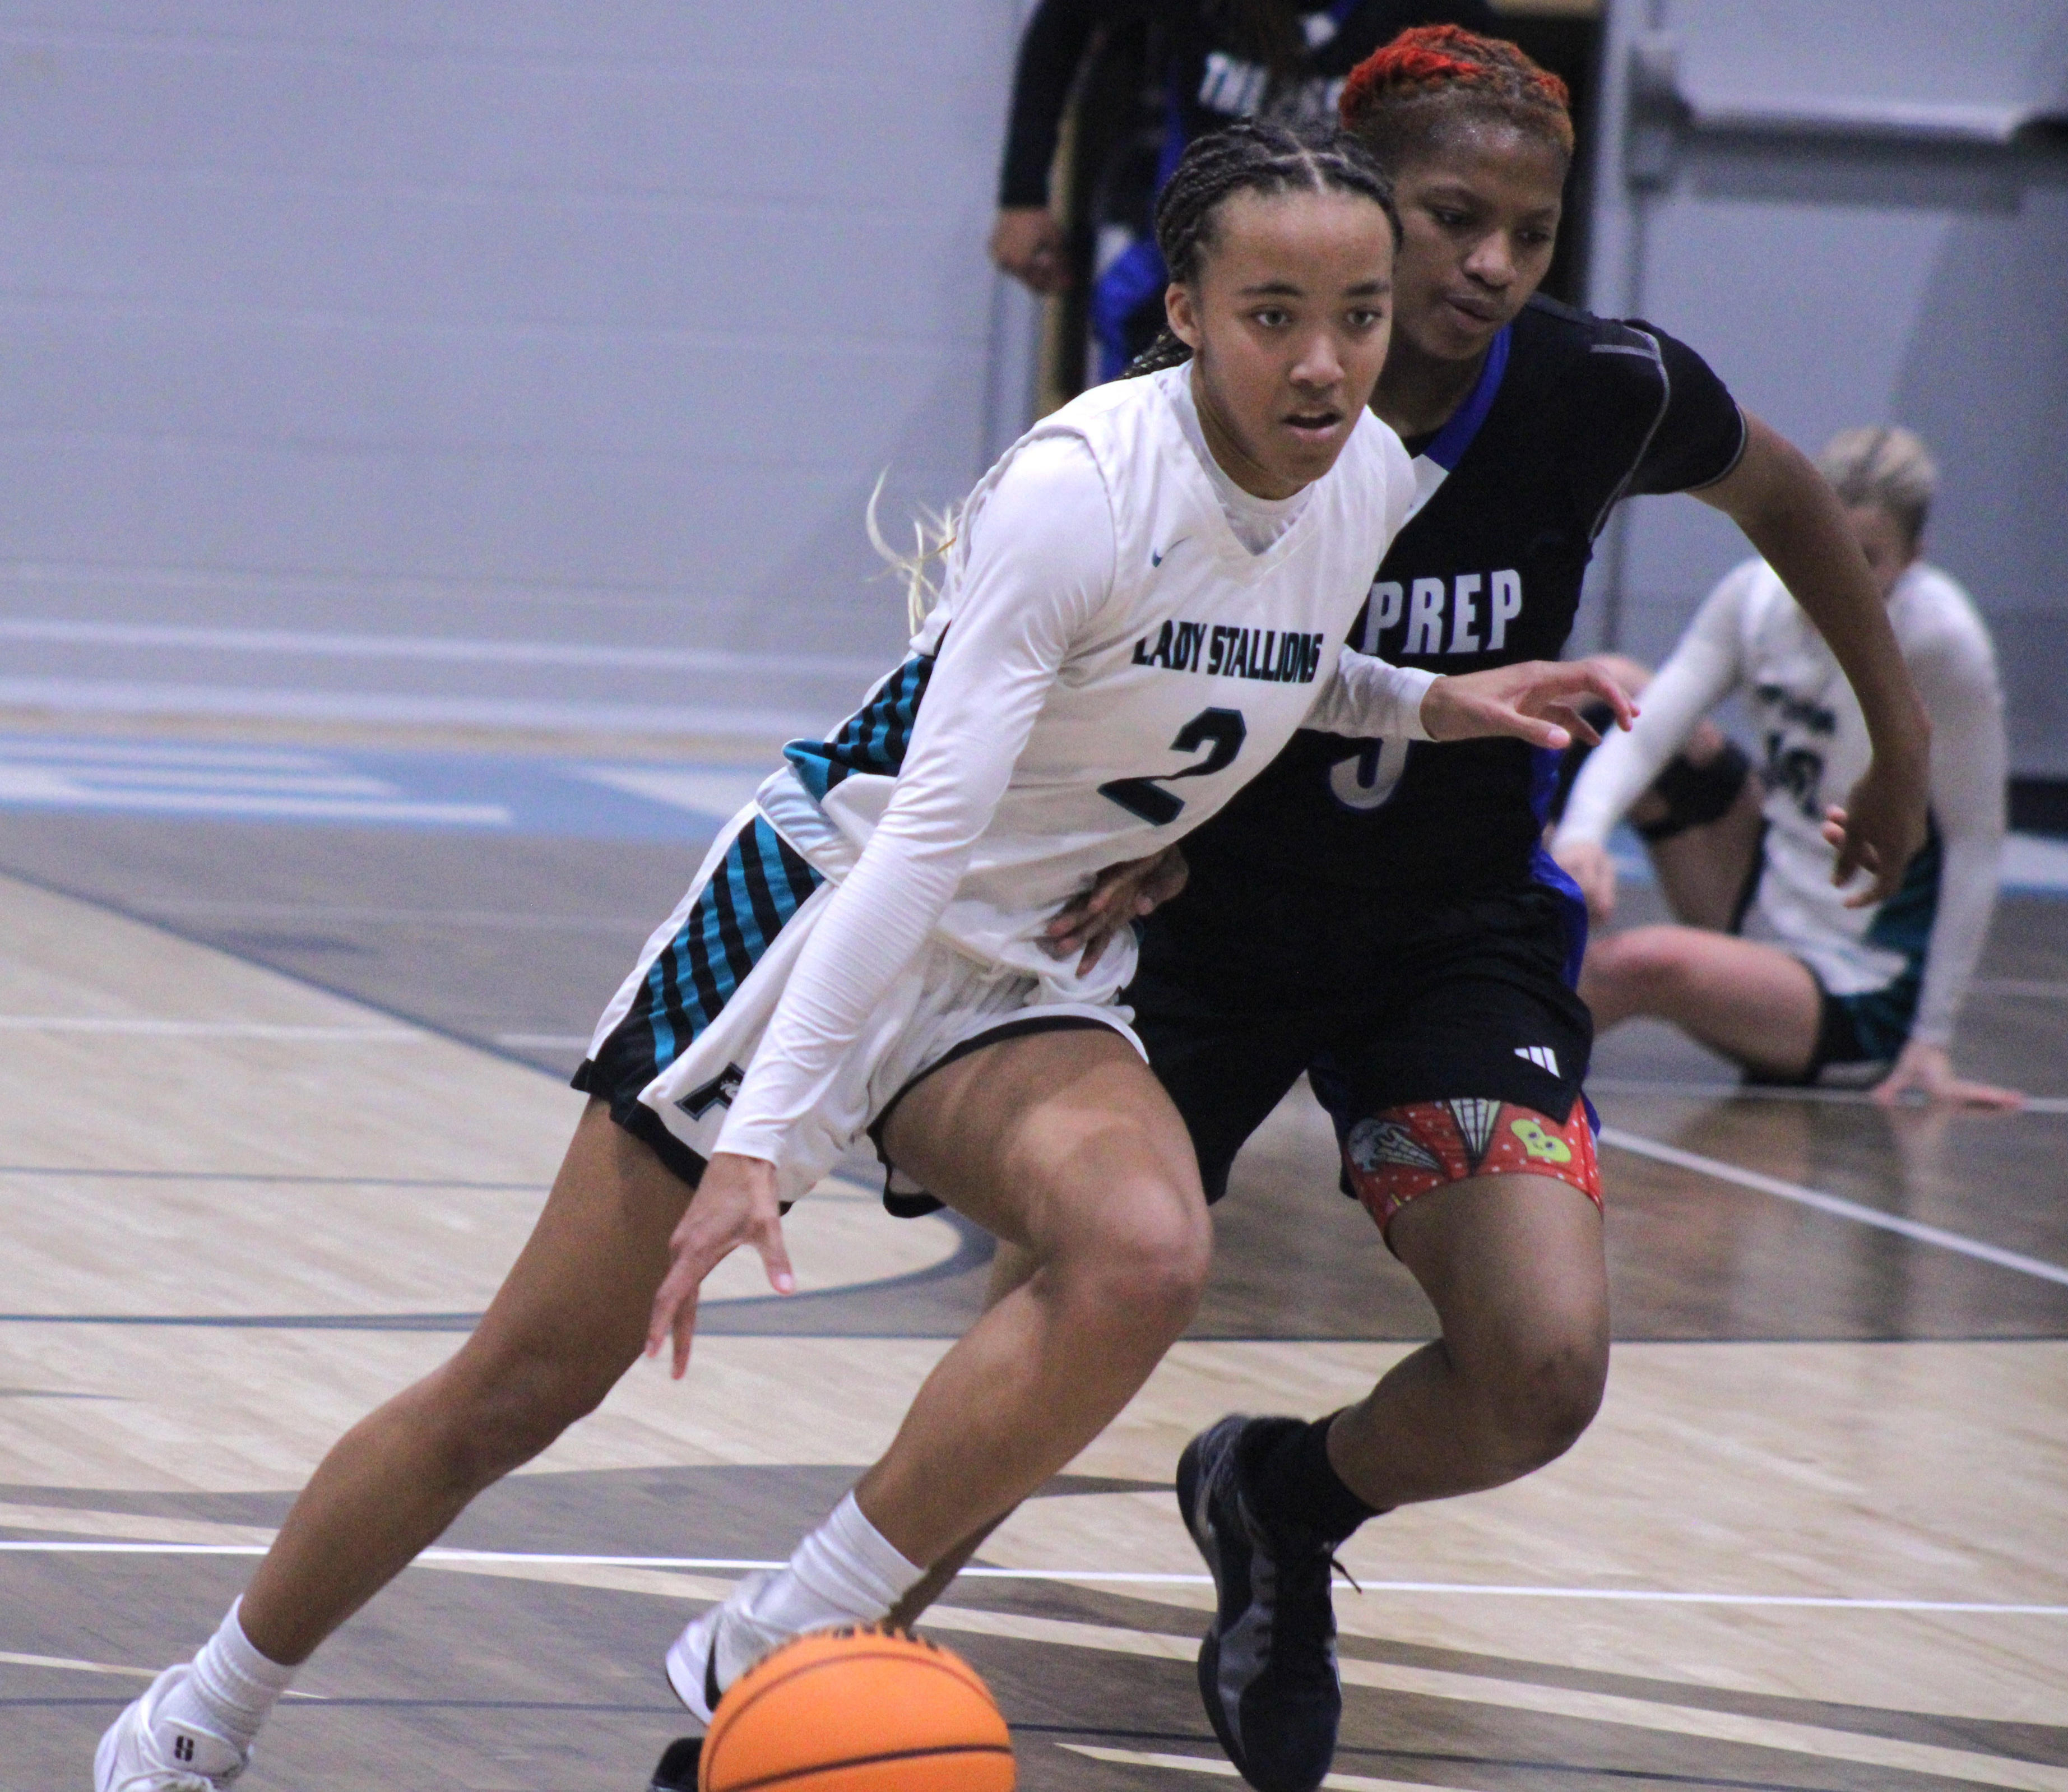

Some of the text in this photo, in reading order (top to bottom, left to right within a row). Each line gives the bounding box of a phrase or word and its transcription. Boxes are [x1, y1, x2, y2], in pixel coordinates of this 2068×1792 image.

[1131, 619, 1324, 683] LADY STALLIONS
[1359, 569, 1522, 655] PREP
[1096, 706, 1247, 826] 2
